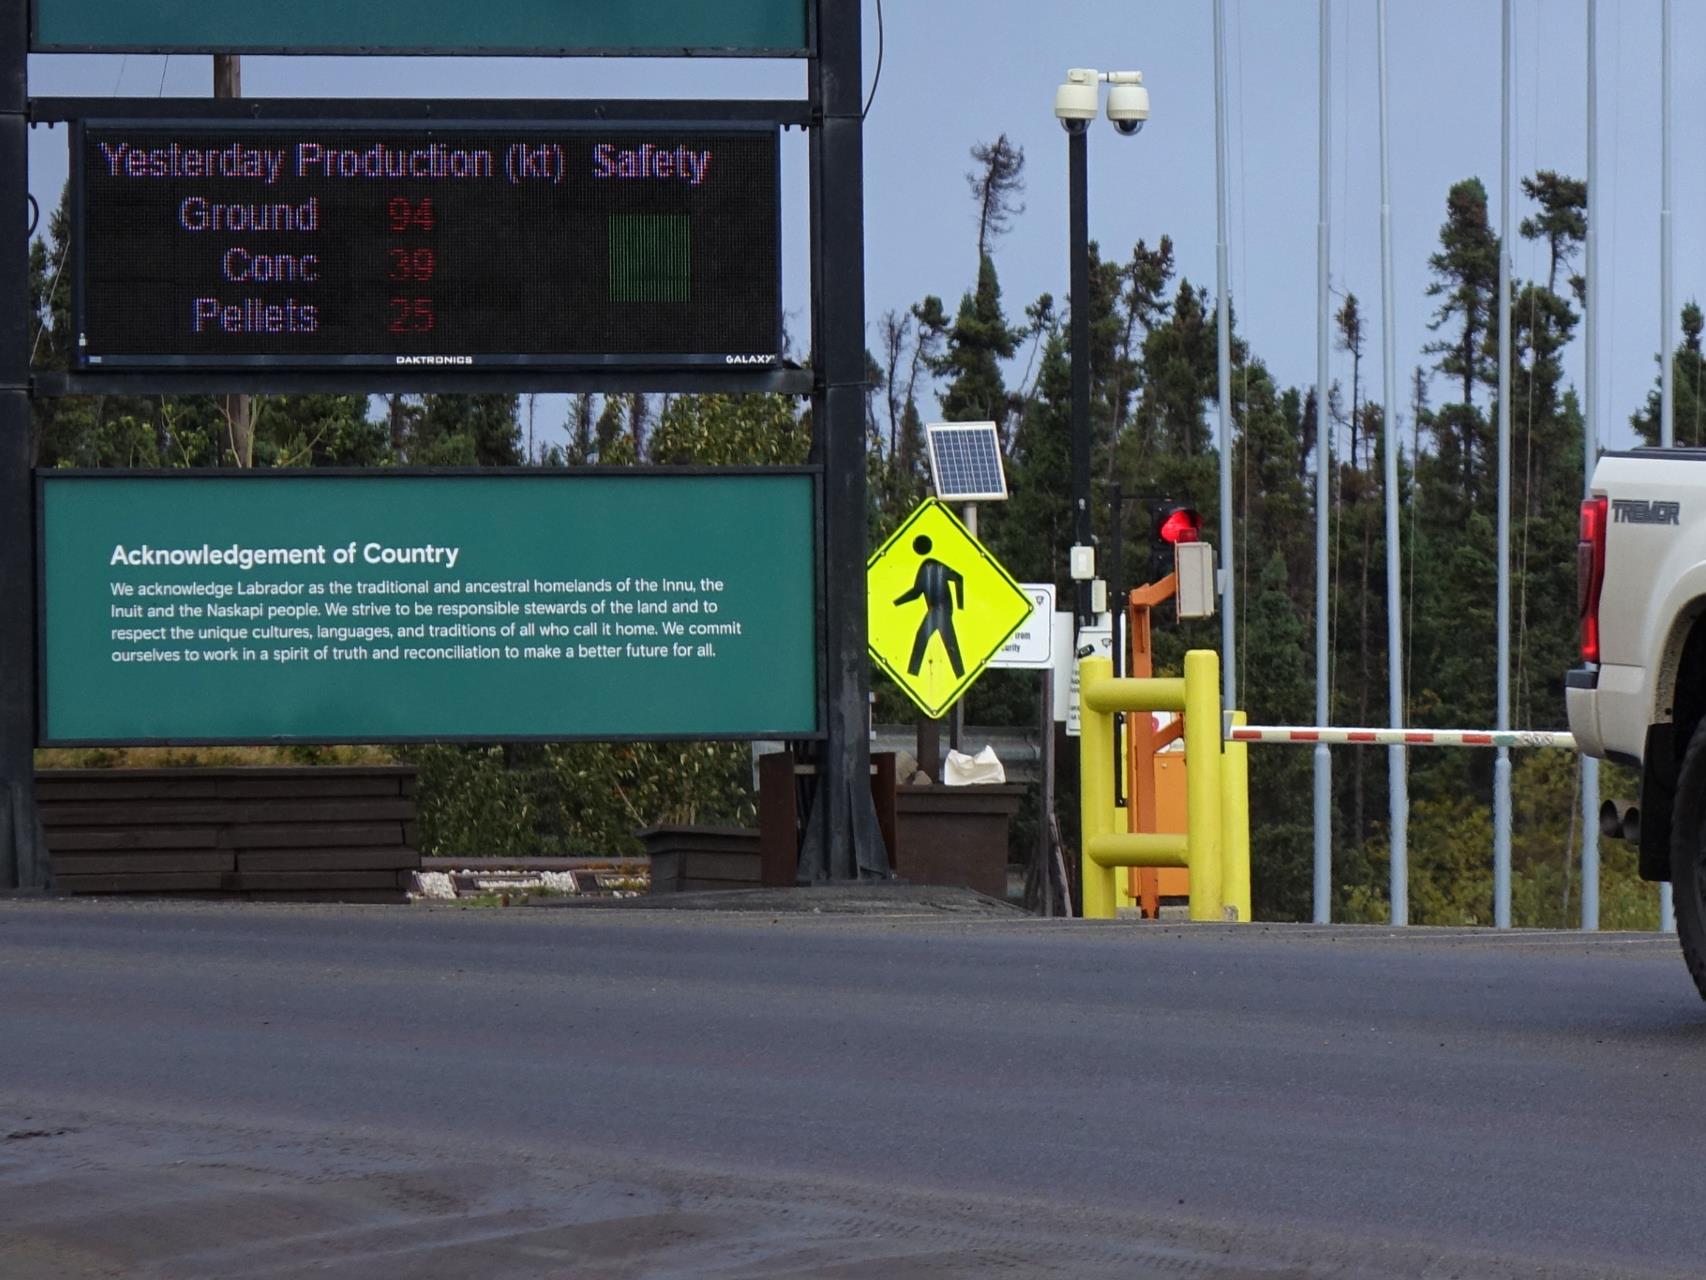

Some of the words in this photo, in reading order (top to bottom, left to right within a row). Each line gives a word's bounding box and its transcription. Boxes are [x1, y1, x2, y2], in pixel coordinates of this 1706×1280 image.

[98, 142, 285, 184] Yesterday
[296, 143, 494, 177] Production
[505, 143, 566, 184] (kt)
[593, 143, 712, 186] Safety
[179, 196, 320, 231] Ground
[388, 197, 434, 231] 94
[222, 247, 320, 282] Conc
[387, 248, 435, 281] 39
[192, 297, 320, 332] Pellets
[387, 297, 435, 332] 25
[396, 355, 473, 366] DAKTRONICS
[1611, 499, 1680, 526] TREMOR
[110, 544, 325, 569] Acknowledgement
[333, 542, 356, 563] of
[364, 543, 459, 567] Country
[110, 582, 134, 596] We
[137, 581, 233, 599] acknowledge
[237, 581, 305, 595] Labrador
[308, 583, 325, 594] as
[328, 580, 353, 595] the
[356, 580, 429, 594] traditional
[433, 579, 461, 594] and
[465, 579, 530, 594] ancestral
[533, 578, 613, 593] homelands
[616, 577, 632, 592] of
[634, 577, 659, 593] the
[662, 578, 697, 593] Innu,
[699, 577, 725, 592] the
[111, 604, 143, 618] Inuit
[147, 604, 175, 618] and
[178, 604, 203, 618] the
[207, 603, 263, 620] Naskapi
[268, 602, 321, 620] people.
[324, 602, 348, 616] We
[351, 602, 391, 616] strive
[394, 603, 411, 616] to
[414, 601, 433, 616] be
[437, 600, 520, 618] responsible
[524, 600, 588, 615] stewards
[590, 599, 606, 614] of
[609, 599, 634, 614] the
[637, 599, 668, 614] land
[671, 599, 699, 614] and
[702, 599, 719, 614] to
[111, 627, 167, 643] respect
[170, 626, 195, 640] the
[198, 626, 248, 642] unique
[252, 625, 313, 640] cultures,
[317, 624, 394, 641] languages,
[397, 623, 425, 638] and
[428, 623, 497, 638] traditions
[500, 622, 516, 637] of
[519, 622, 535, 637] all
[539, 622, 570, 637] who
[573, 622, 598, 636] call
[602, 622, 611, 636] it
[615, 622, 658, 636] home.
[661, 621, 685, 636] We
[688, 620, 742, 635] commit
[111, 647, 181, 662] ourselves
[183, 648, 200, 662] to
[202, 647, 239, 661] work
[242, 647, 256, 661] in
[259, 649, 269, 661] a
[273, 646, 310, 664] spirit
[313, 645, 329, 660] of
[332, 645, 368, 660] truth
[371, 645, 400, 660] and
[403, 644, 501, 660] reconciliation
[504, 645, 520, 659] to
[523, 644, 562, 659] make
[565, 646, 575, 659] a
[578, 643, 623, 658] better
[626, 642, 669, 658] future
[672, 641, 694, 657] for
[696, 642, 716, 657] all.
